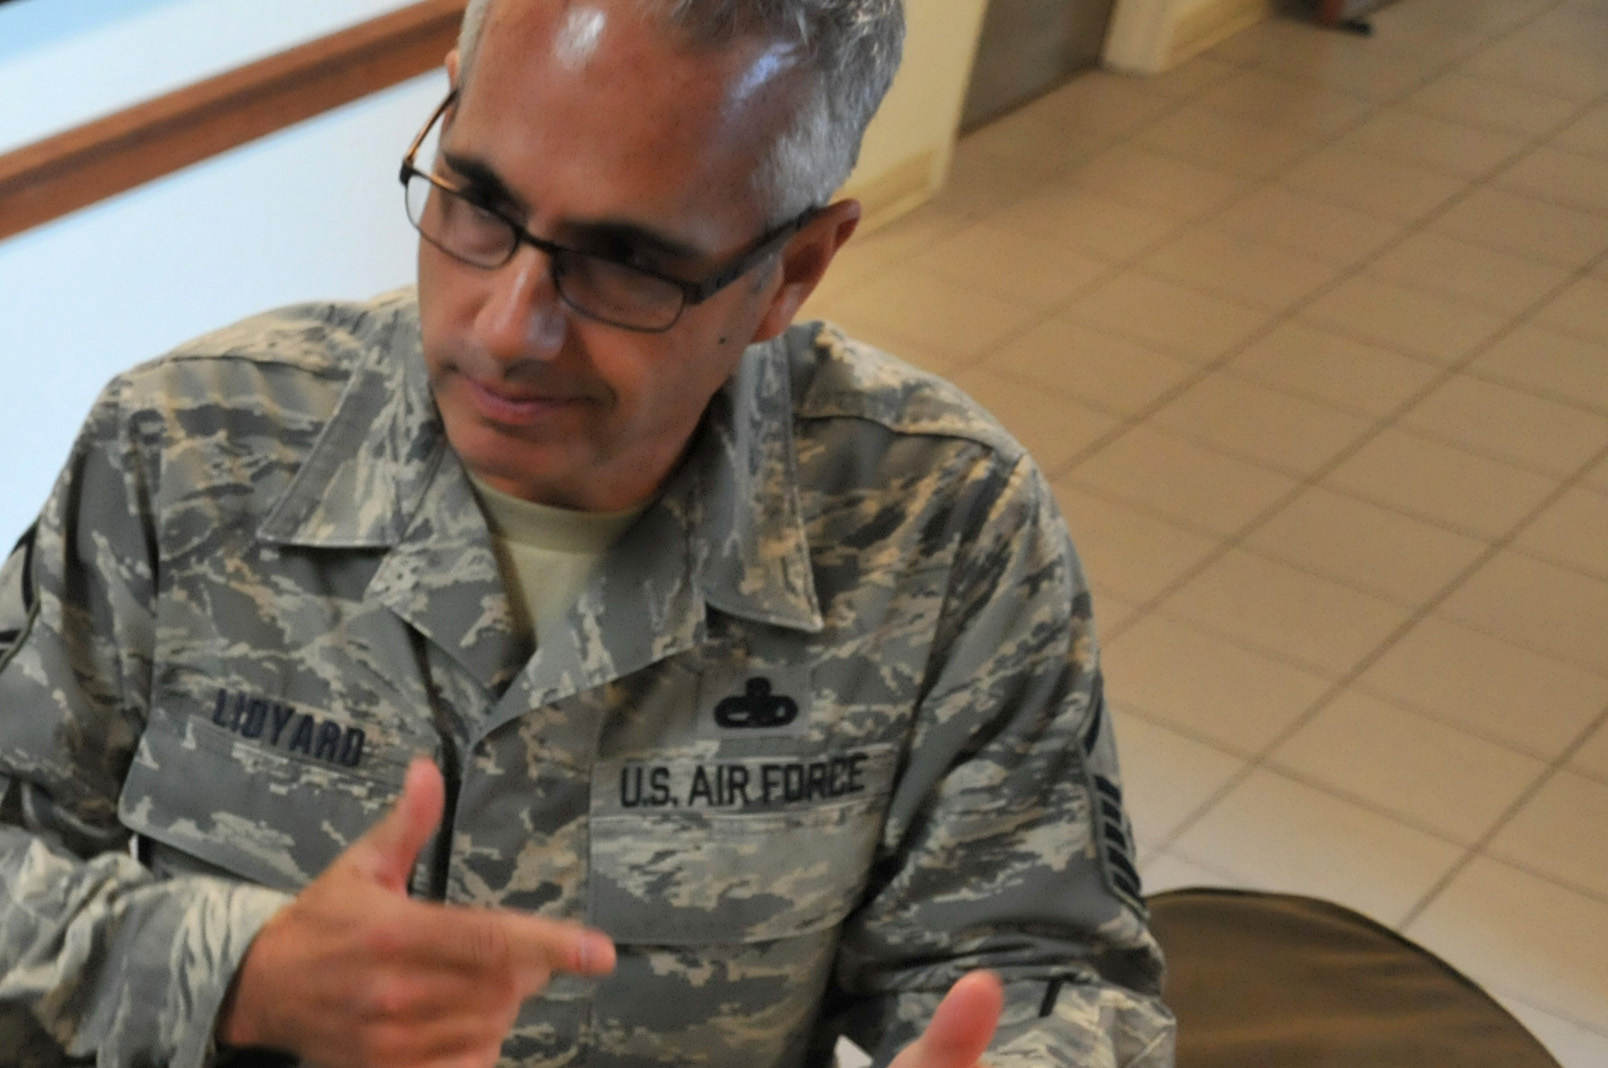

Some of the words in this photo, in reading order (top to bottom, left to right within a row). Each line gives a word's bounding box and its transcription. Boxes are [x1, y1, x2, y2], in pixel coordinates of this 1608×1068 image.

[212, 688, 366, 767] LIDYARD
[621, 766, 678, 808] U.S.
[689, 765, 749, 806] AIR
[761, 752, 869, 804] FORCE
